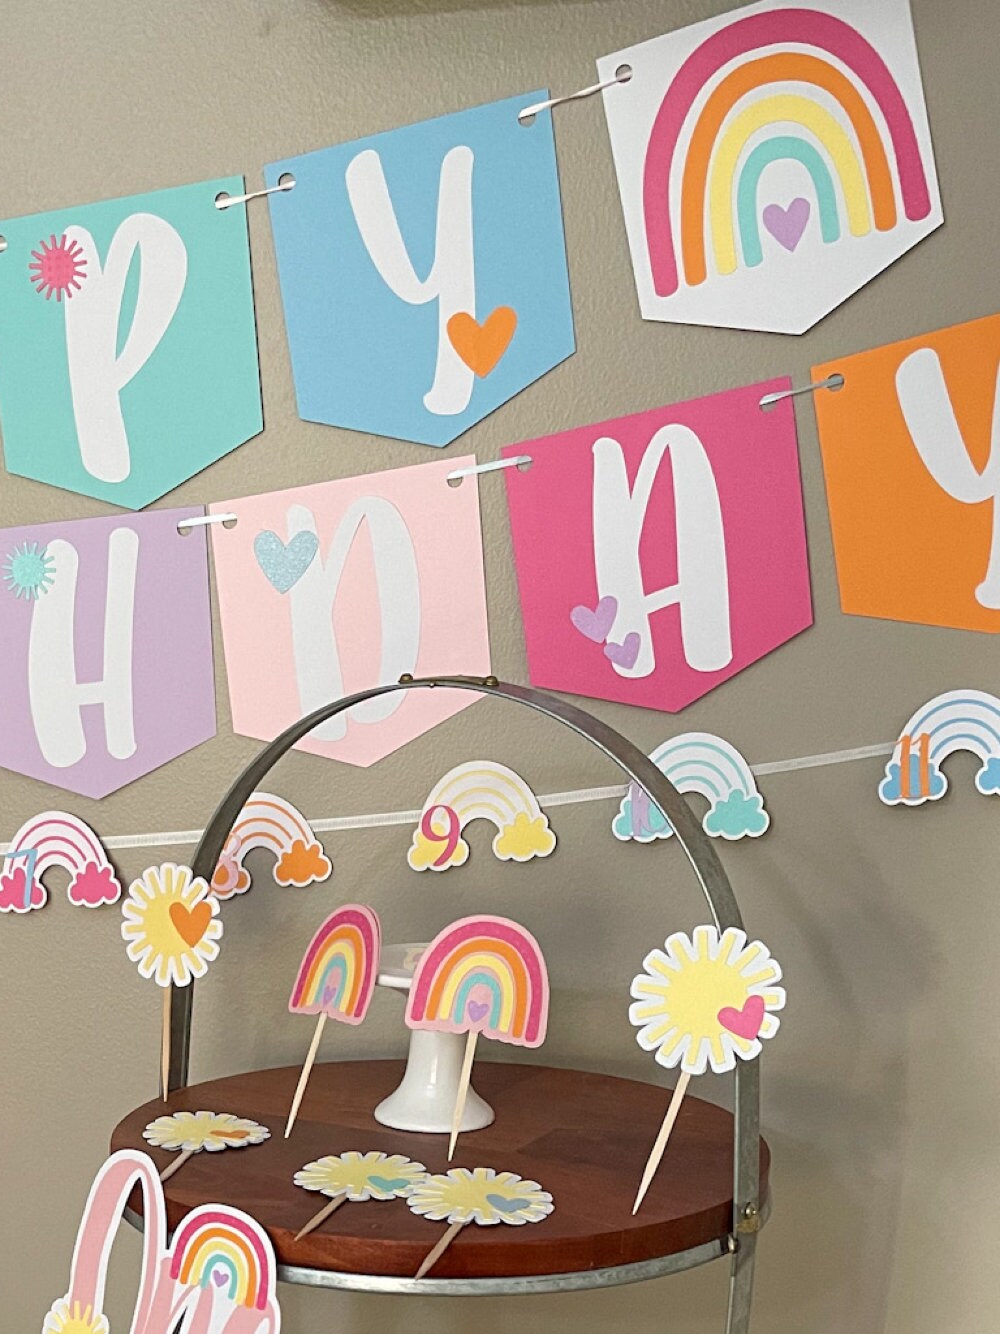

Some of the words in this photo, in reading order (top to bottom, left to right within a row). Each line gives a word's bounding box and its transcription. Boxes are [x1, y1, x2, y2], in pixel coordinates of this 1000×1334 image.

[895, 733, 930, 799] 11
[421, 804, 460, 865] 9
[6, 849, 37, 908] 7
